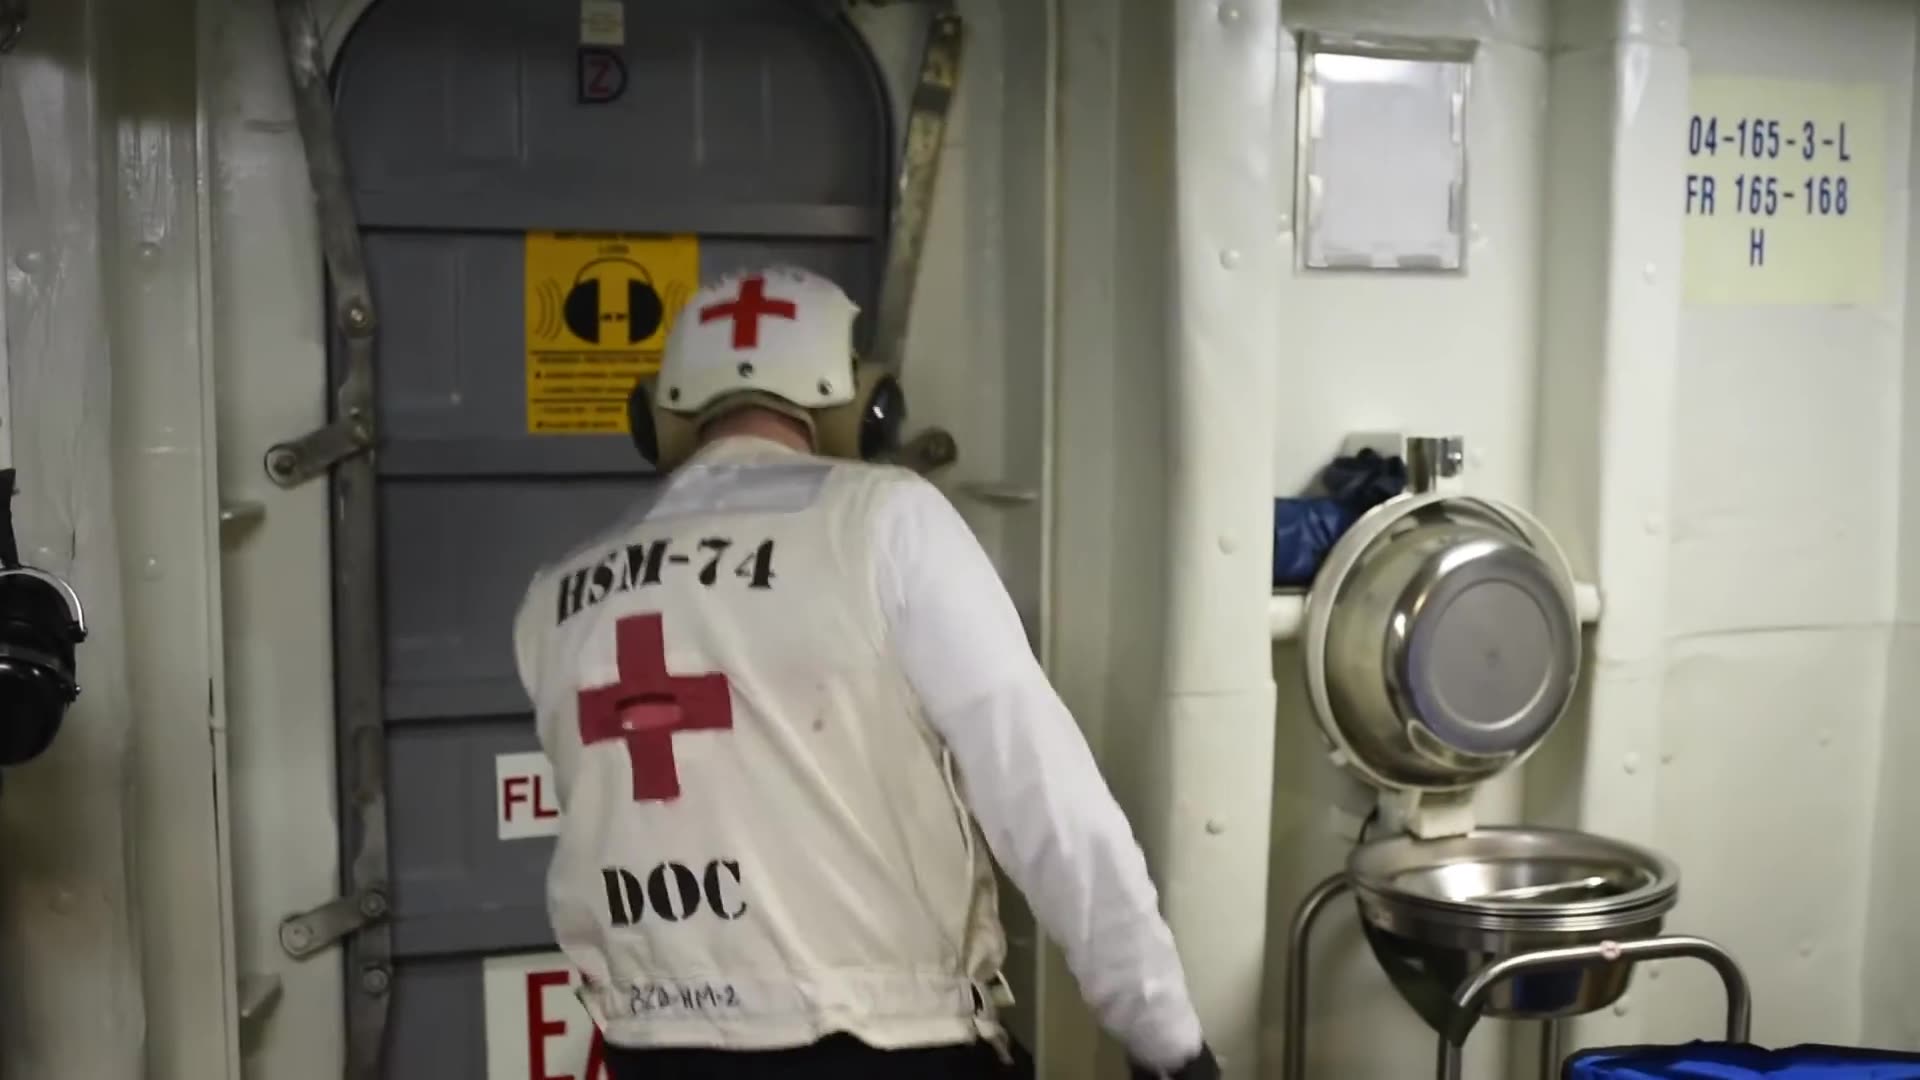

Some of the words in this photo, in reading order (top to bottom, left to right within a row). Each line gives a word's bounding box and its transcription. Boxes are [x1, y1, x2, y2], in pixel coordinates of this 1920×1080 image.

[1688, 114, 1851, 162] 04-165-3-L
[1685, 174, 1716, 216] FR
[1749, 228, 1766, 267] H
[556, 535, 777, 626] HSM-74
[503, 774, 559, 822] FL
[602, 858, 748, 927] DOC
